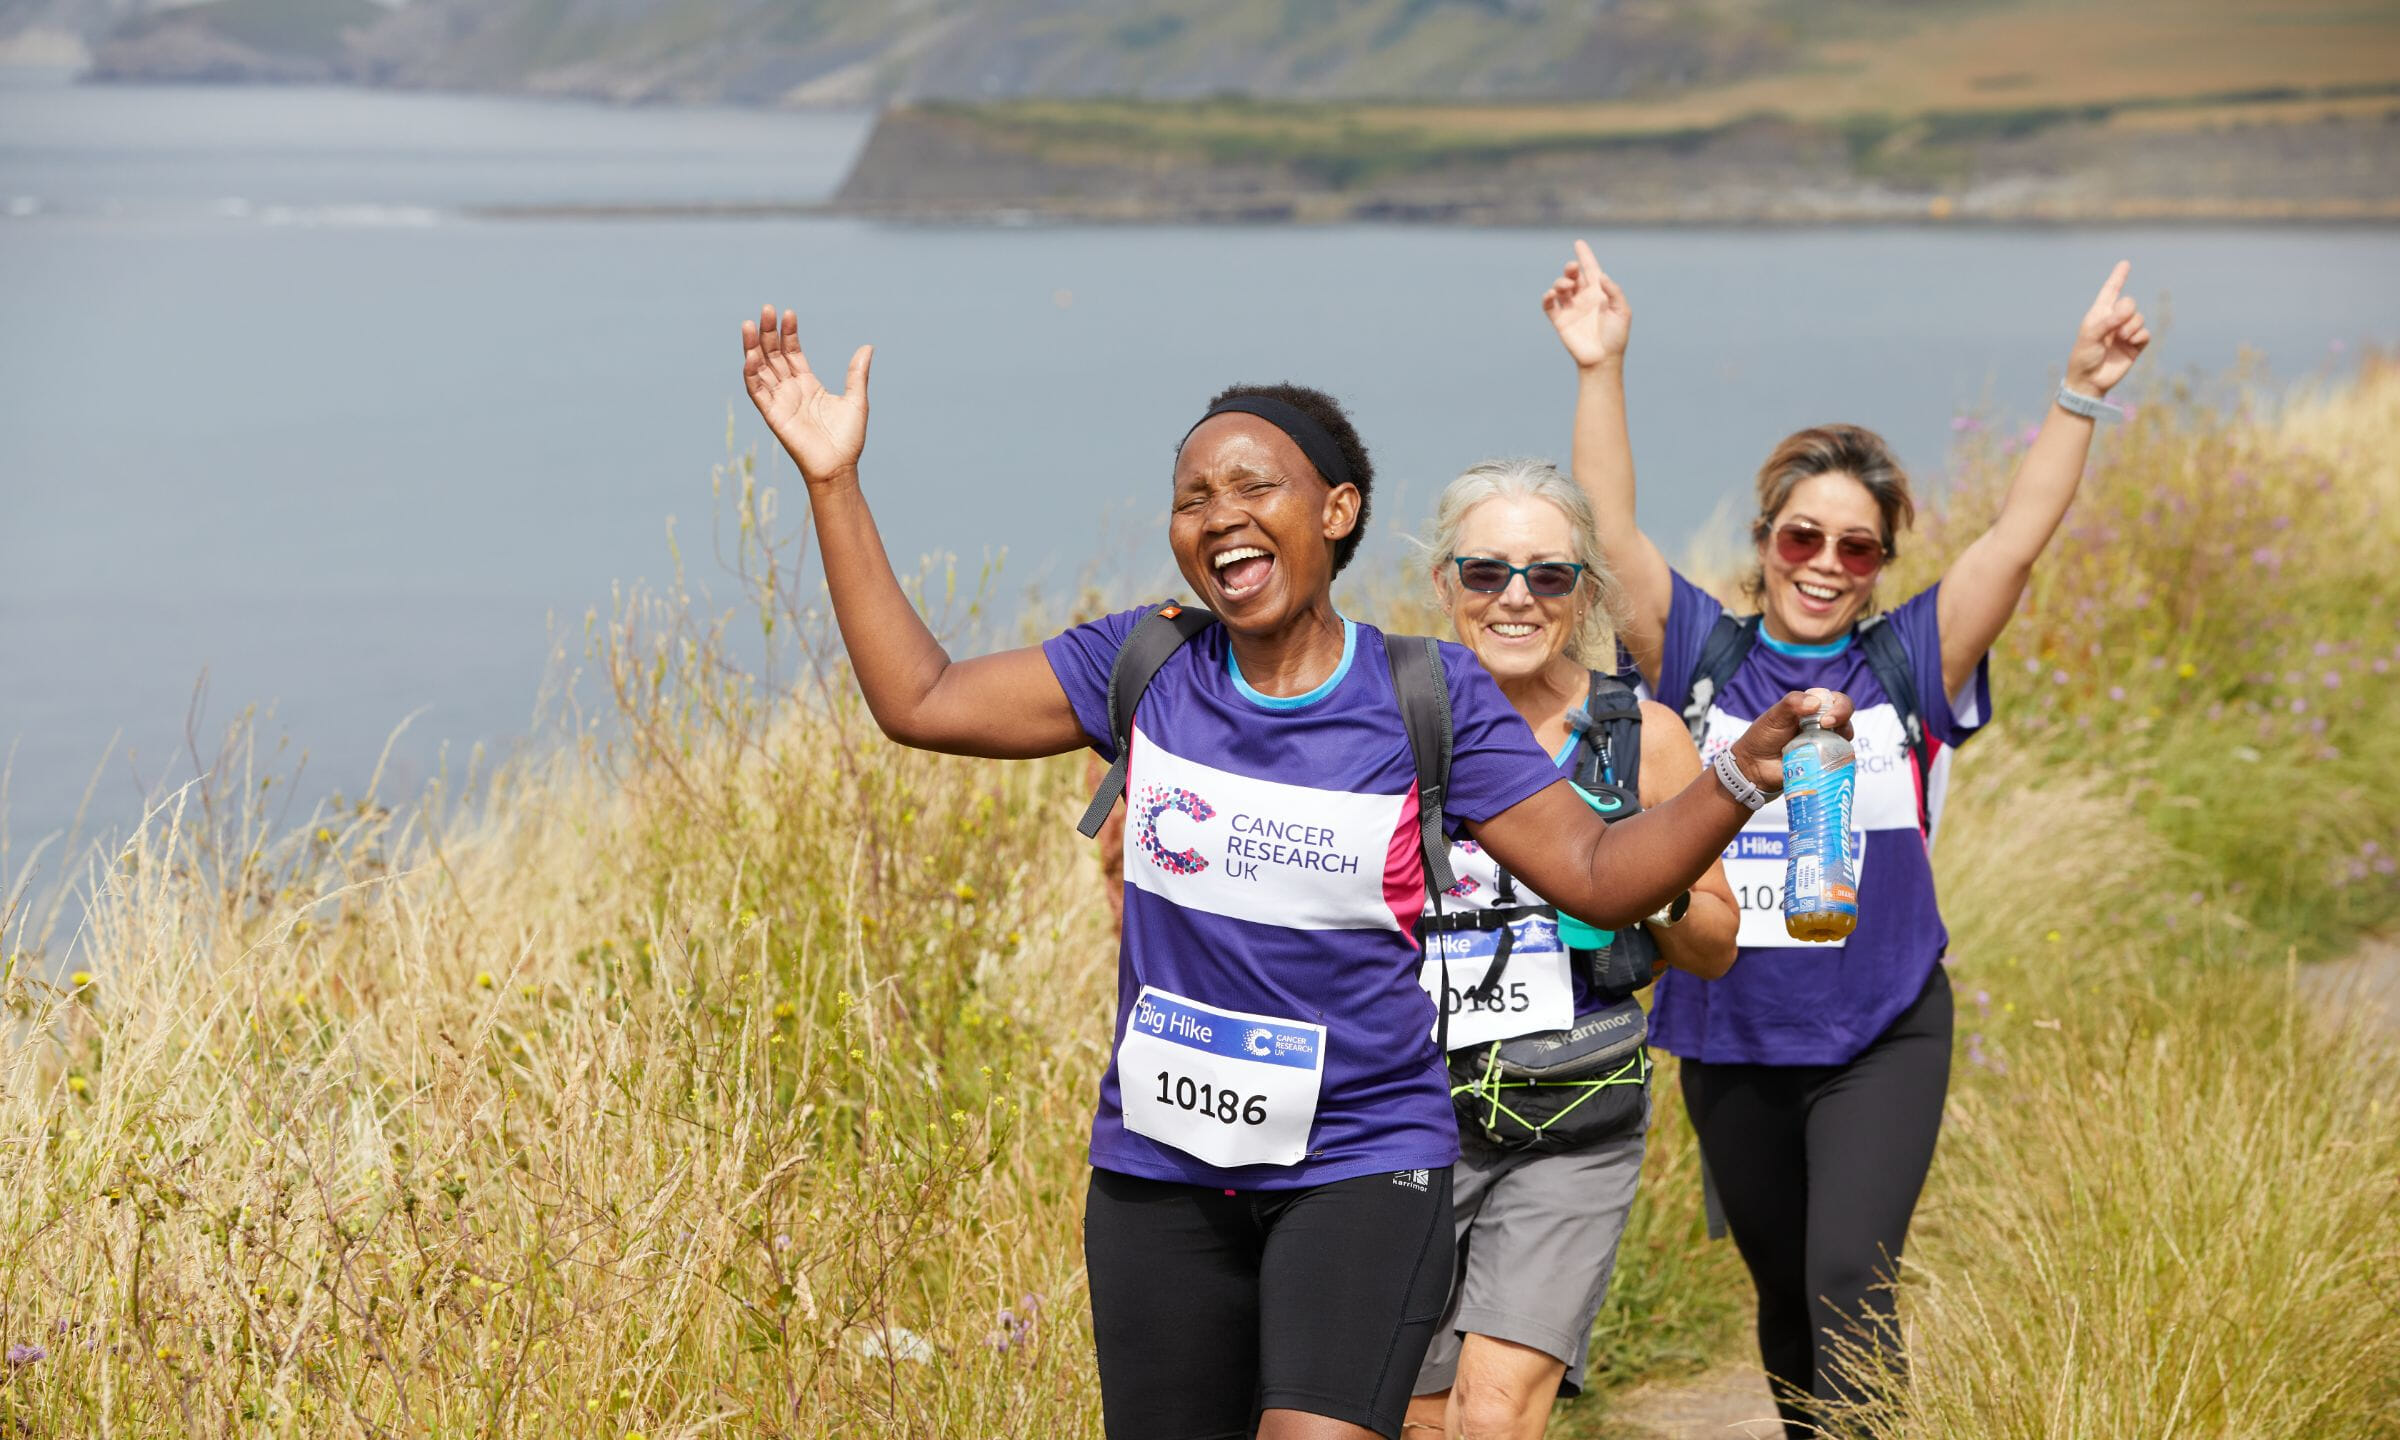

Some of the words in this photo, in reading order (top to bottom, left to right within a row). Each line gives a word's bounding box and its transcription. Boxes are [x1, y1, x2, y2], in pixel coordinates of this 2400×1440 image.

[1231, 814, 1335, 848] CANCER
[1227, 836, 1359, 874] RESEARCH
[1742, 836, 1784, 855] Hike
[1225, 857, 1258, 882] UK
[1426, 934, 1471, 953] Hike
[1139, 1002, 1166, 1034] Big
[1169, 1012, 1213, 1044] Hike
[1560, 1011, 1632, 1046] karrimor
[1275, 1041, 1313, 1053] RESEARCH
[1276, 1034, 1307, 1045] CANCER
[1274, 1049, 1286, 1057] UK
[1156, 1071, 1267, 1125] 10186
[1392, 1178, 1428, 1193] karrimor
